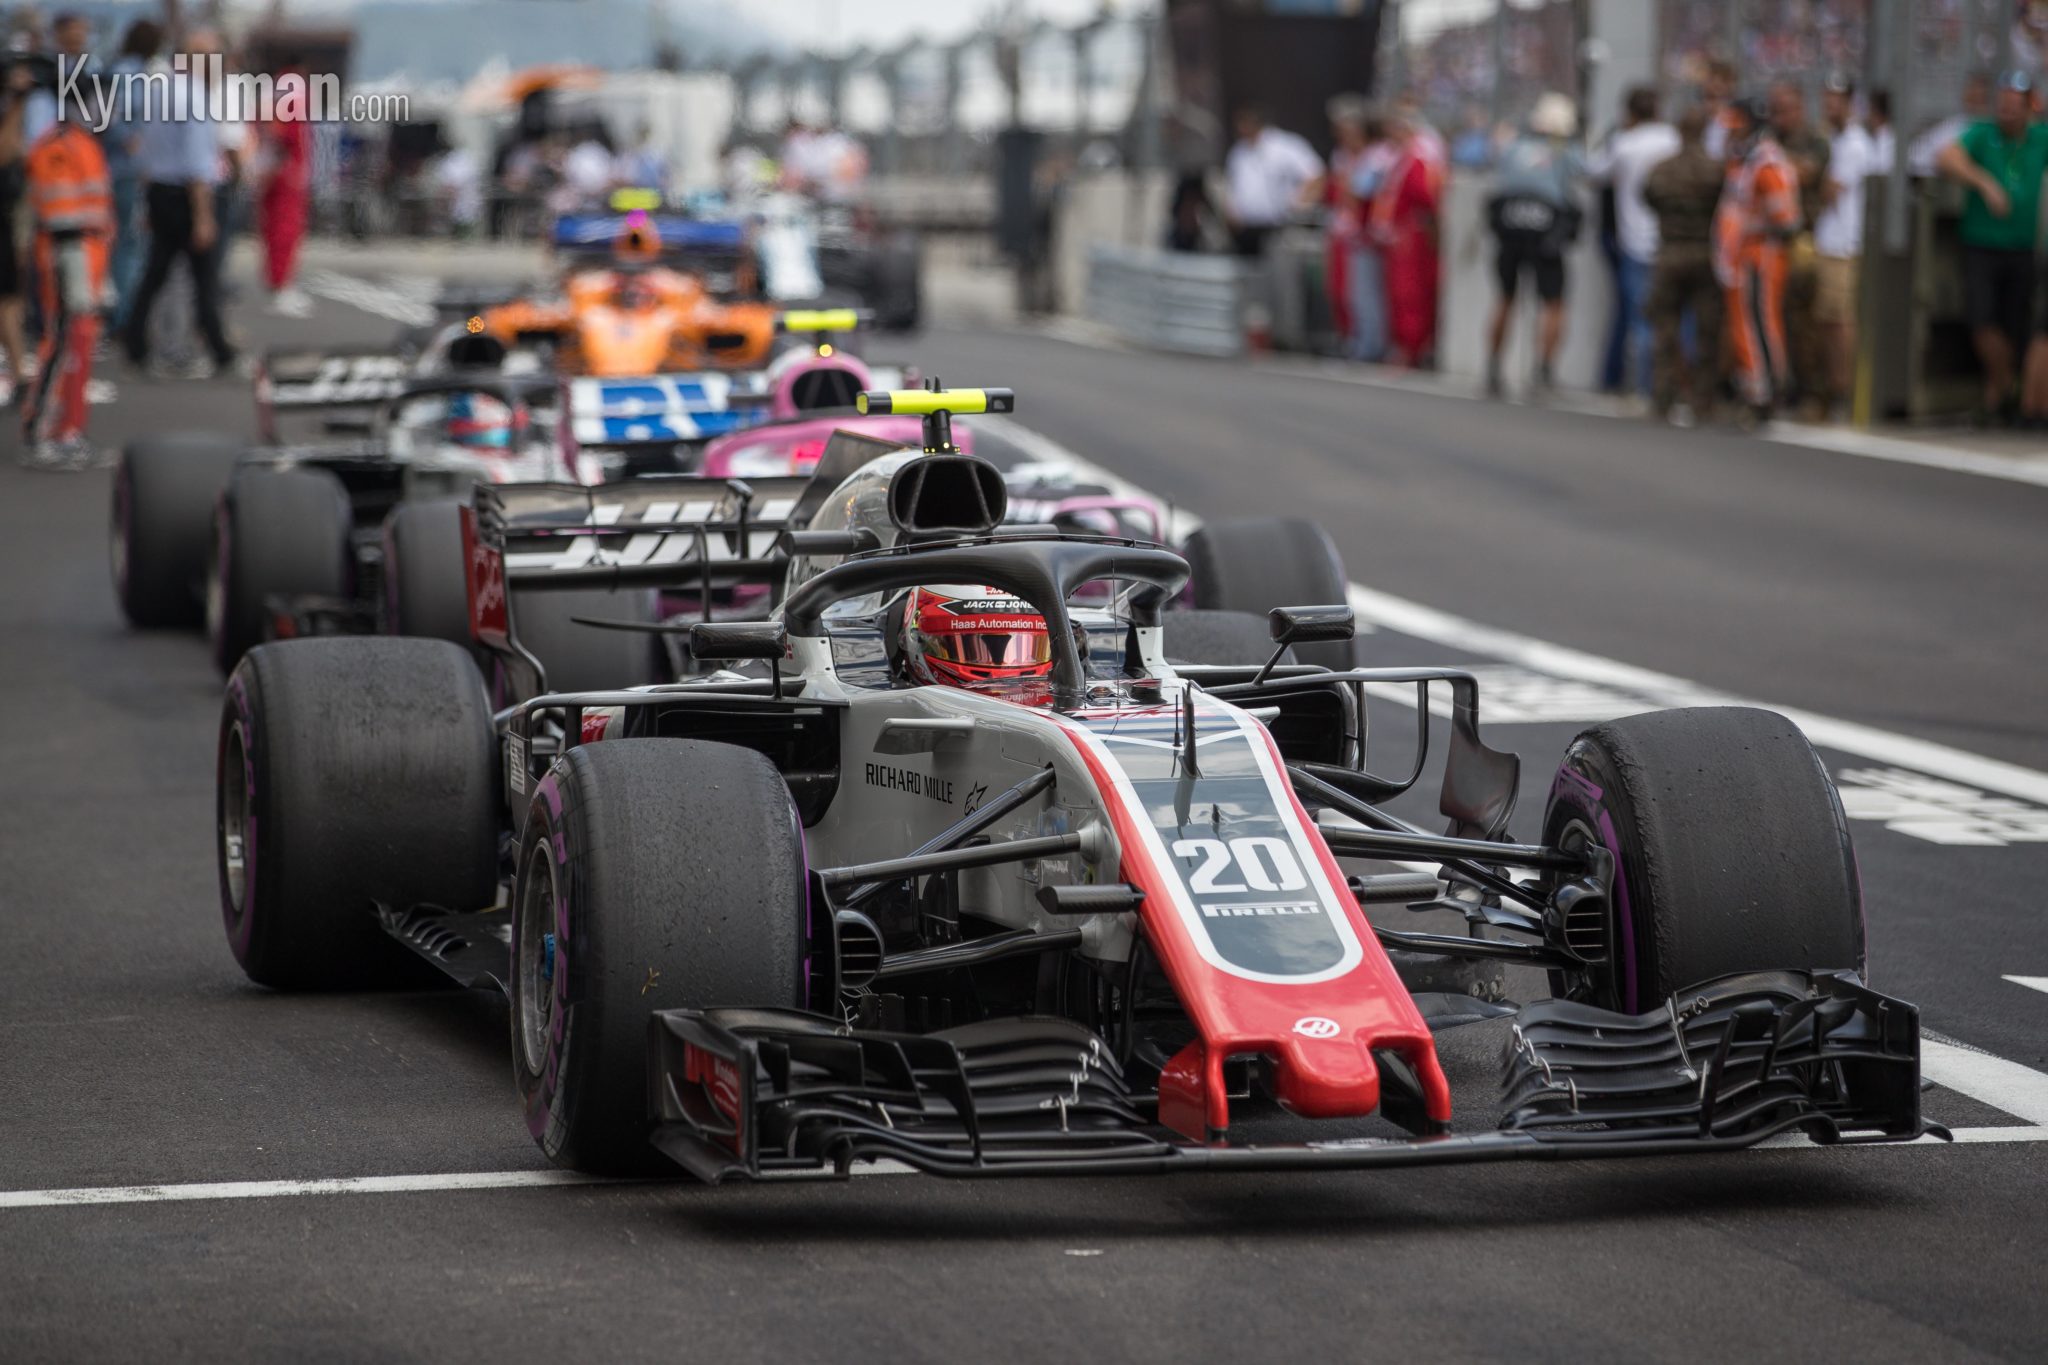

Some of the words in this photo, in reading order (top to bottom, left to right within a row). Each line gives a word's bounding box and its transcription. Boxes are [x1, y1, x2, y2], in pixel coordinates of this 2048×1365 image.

[951, 620, 976, 629] Haas
[978, 619, 1033, 629] Automation
[866, 763, 921, 795] RICHARD
[924, 775, 953, 804] MILLE
[1172, 837, 1307, 894] 20
[1201, 901, 1320, 917] PIRELLI
